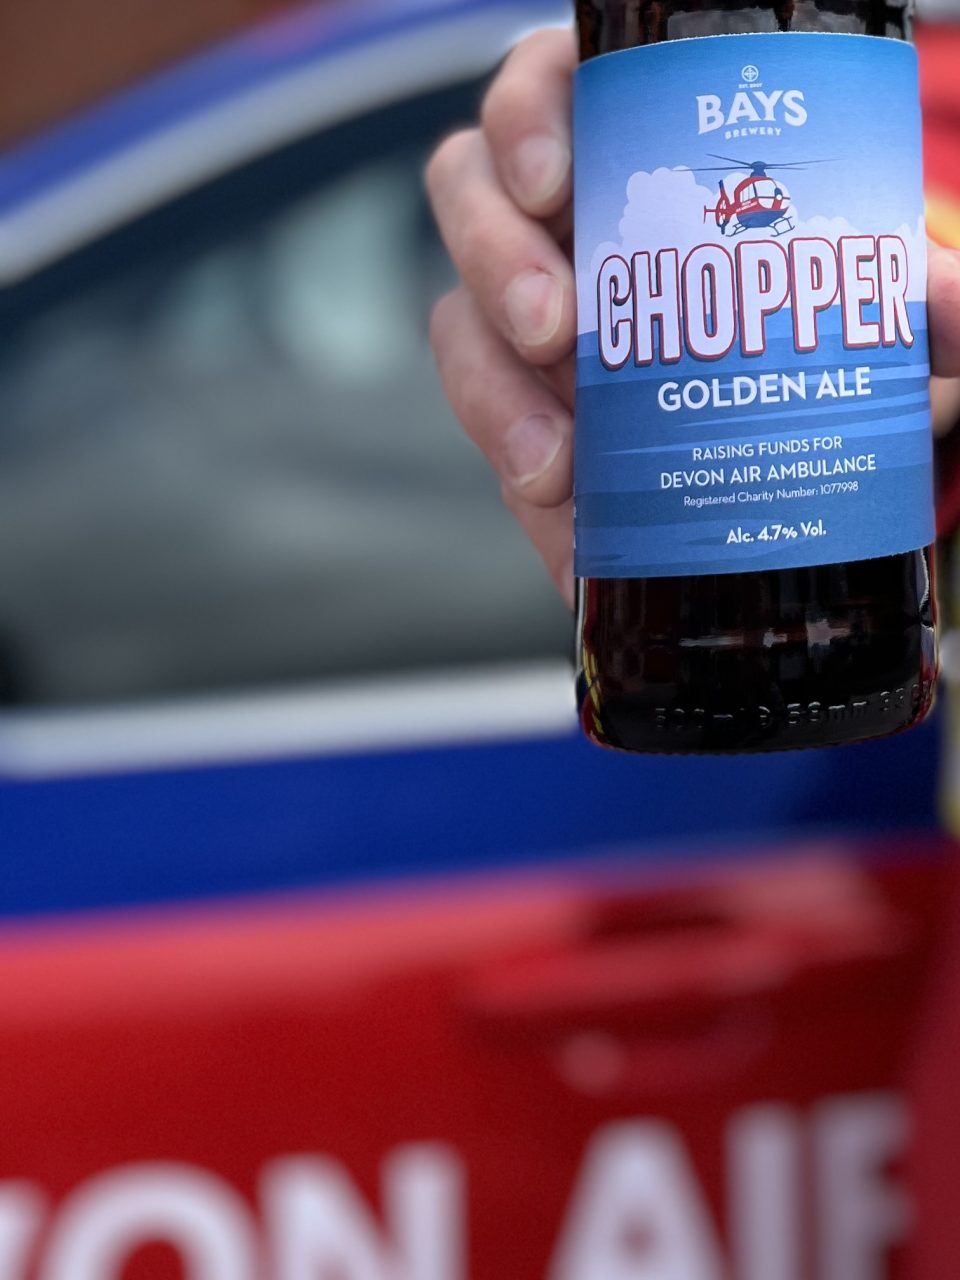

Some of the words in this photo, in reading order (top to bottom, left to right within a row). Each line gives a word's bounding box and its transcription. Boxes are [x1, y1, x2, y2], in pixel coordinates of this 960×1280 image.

[696, 89, 808, 135] BAYS
[724, 126, 782, 140] BREWERY
[597, 234, 915, 370] CHOPPER
[657, 371, 807, 412] GOLDEN
[815, 366, 872, 400] ALE
[692, 443, 755, 461] RAISING
[758, 438, 810, 456] FUNDS
[813, 435, 843, 451] FOR
[660, 468, 725, 489] DEVON
[729, 465, 761, 484] AIR
[767, 453, 877, 481] AMBULANCE
[683, 492, 736, 508] Registered
[737, 488, 775, 503] Charity
[776, 486, 819, 499] Number:
[820, 480, 859, 495] 1077998
[726, 527, 755, 544] Alc.
[757, 524, 798, 541] 4.7%
[800, 518, 827, 536] Vol.
